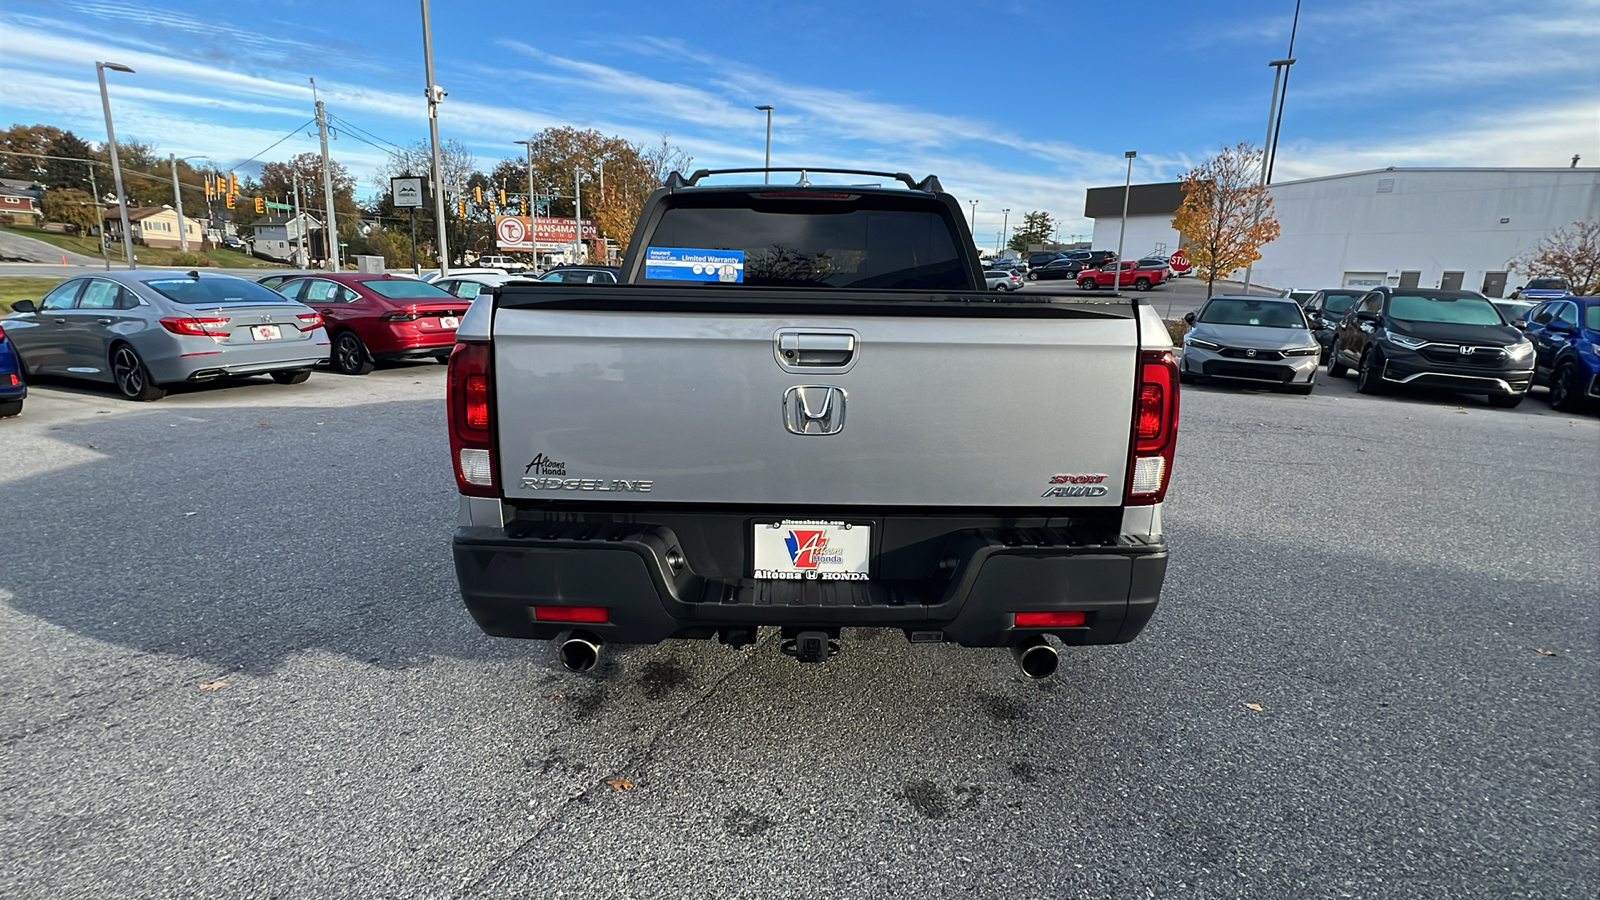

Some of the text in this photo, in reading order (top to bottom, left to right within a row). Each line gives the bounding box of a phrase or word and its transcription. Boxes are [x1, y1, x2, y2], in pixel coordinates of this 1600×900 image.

[526, 223, 597, 234] TRANS4MAON
[681, 254, 739, 264] Limited Warranty
[525, 452, 565, 474] Altoona
[518, 476, 654, 492] RIDGELINE
[1048, 474, 1108, 484] SPORT
[1041, 486, 1109, 497] AWD
[813, 555, 842, 563] Honda
[753, 570, 870, 580] Altoona HONDA
